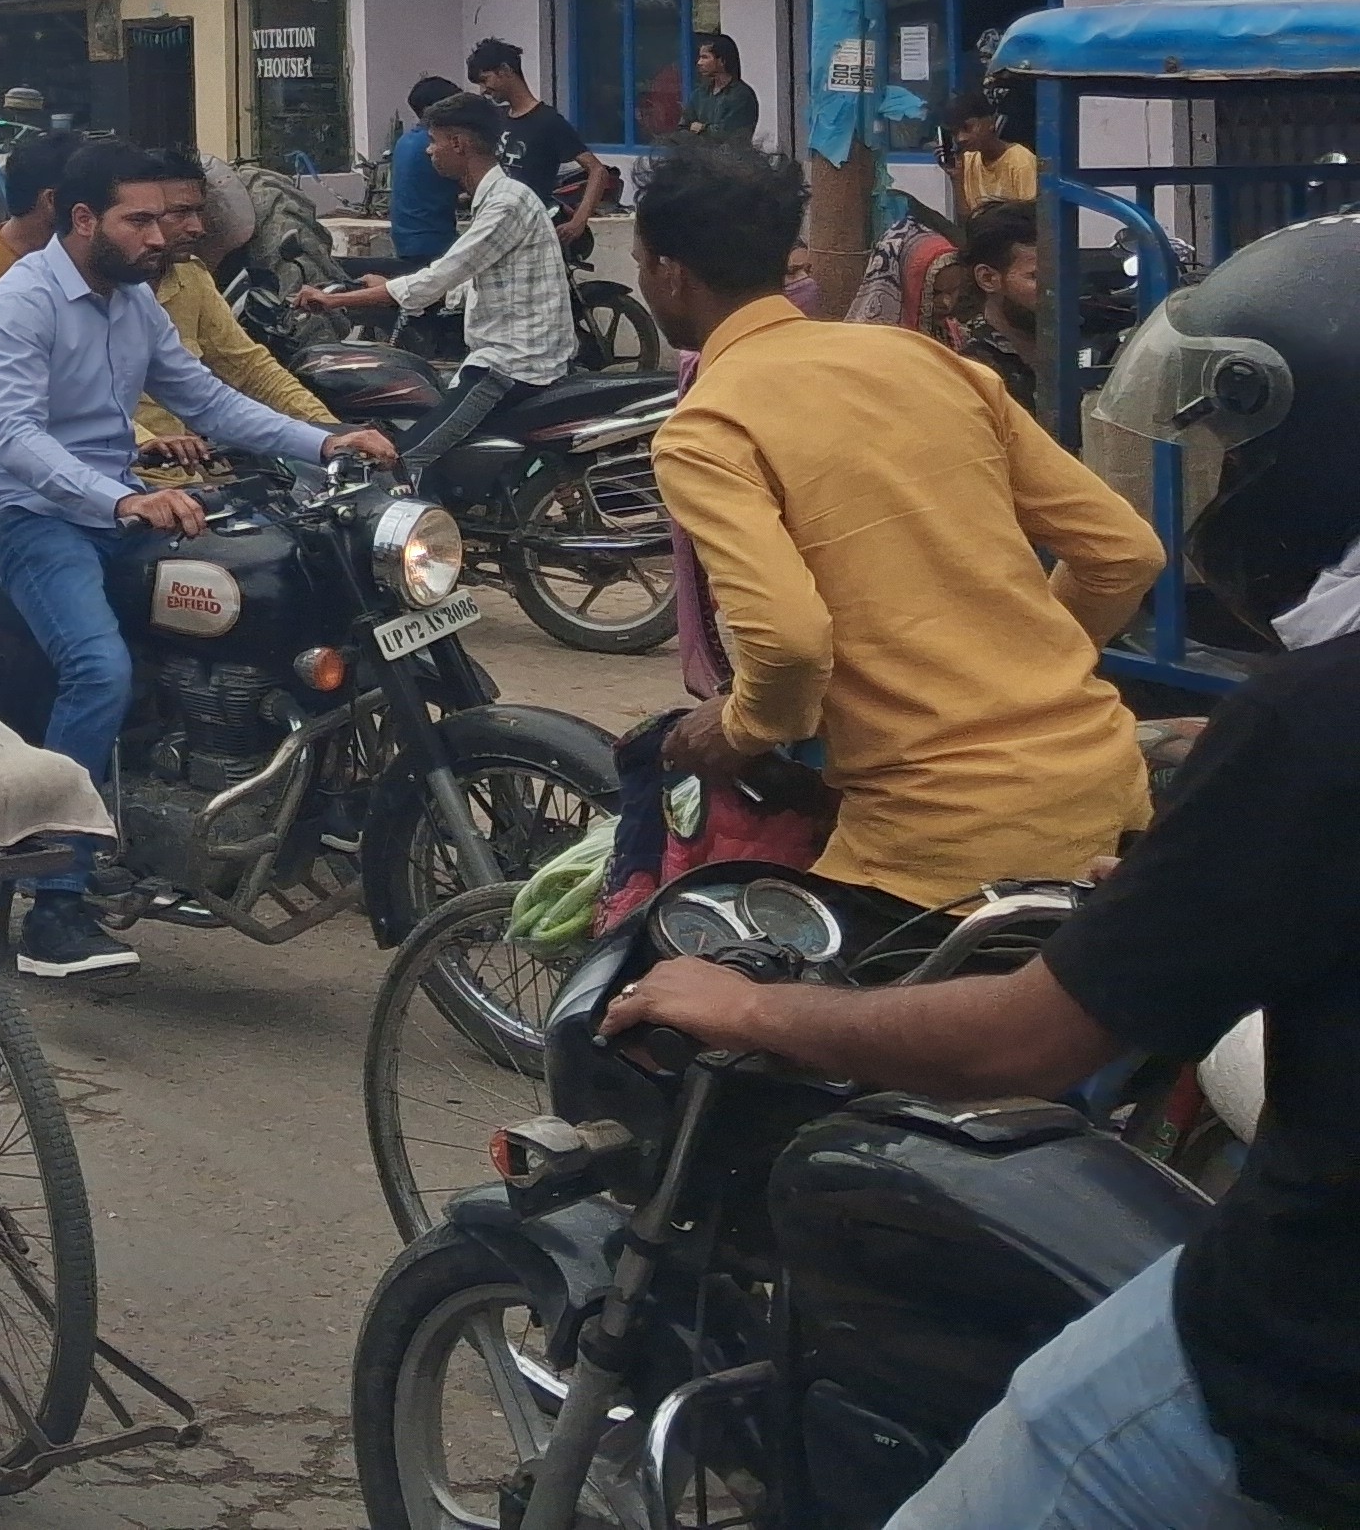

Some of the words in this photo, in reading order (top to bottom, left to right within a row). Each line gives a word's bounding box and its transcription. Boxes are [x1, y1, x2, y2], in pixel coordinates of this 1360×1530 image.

[251, 26, 316, 50] NUTRITION
[264, 57, 307, 79] HOUSE
[171, 580, 217, 600] ROYAL
[166, 595, 223, 616] ENFIELD
[381, 628, 405, 654] UP
[425, 609, 446, 636] AS
